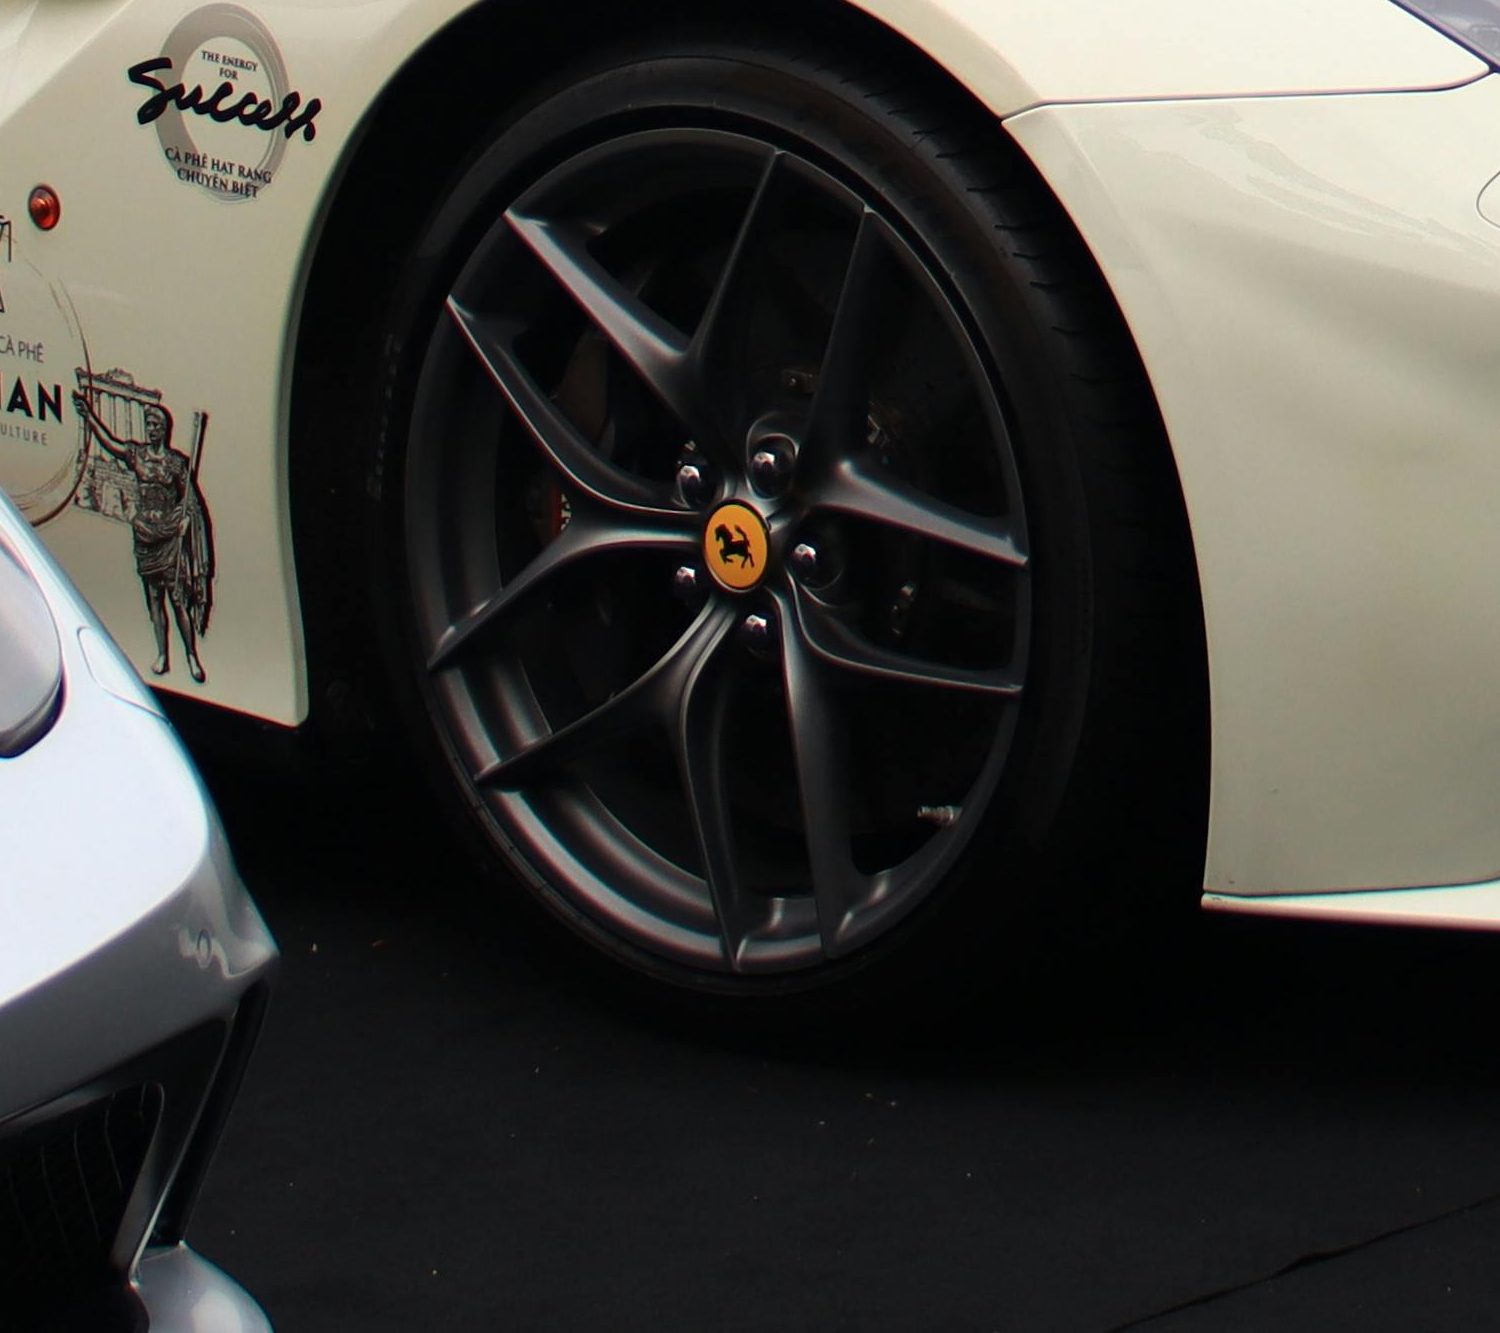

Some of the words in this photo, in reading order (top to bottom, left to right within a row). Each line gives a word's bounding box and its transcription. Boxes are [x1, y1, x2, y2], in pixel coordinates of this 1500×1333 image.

[201, 49, 221, 65] THE
[221, 54, 260, 73] ENERGY
[219, 67, 240, 81] FOR
[127, 55, 323, 143] Success
[165, 144, 183, 163] CÀ
[184, 150, 209, 170] PHÊ
[237, 164, 273, 185] RANG
[176, 166, 233, 192] CHUYÊN
[17, 339, 46, 364] PHÊ
